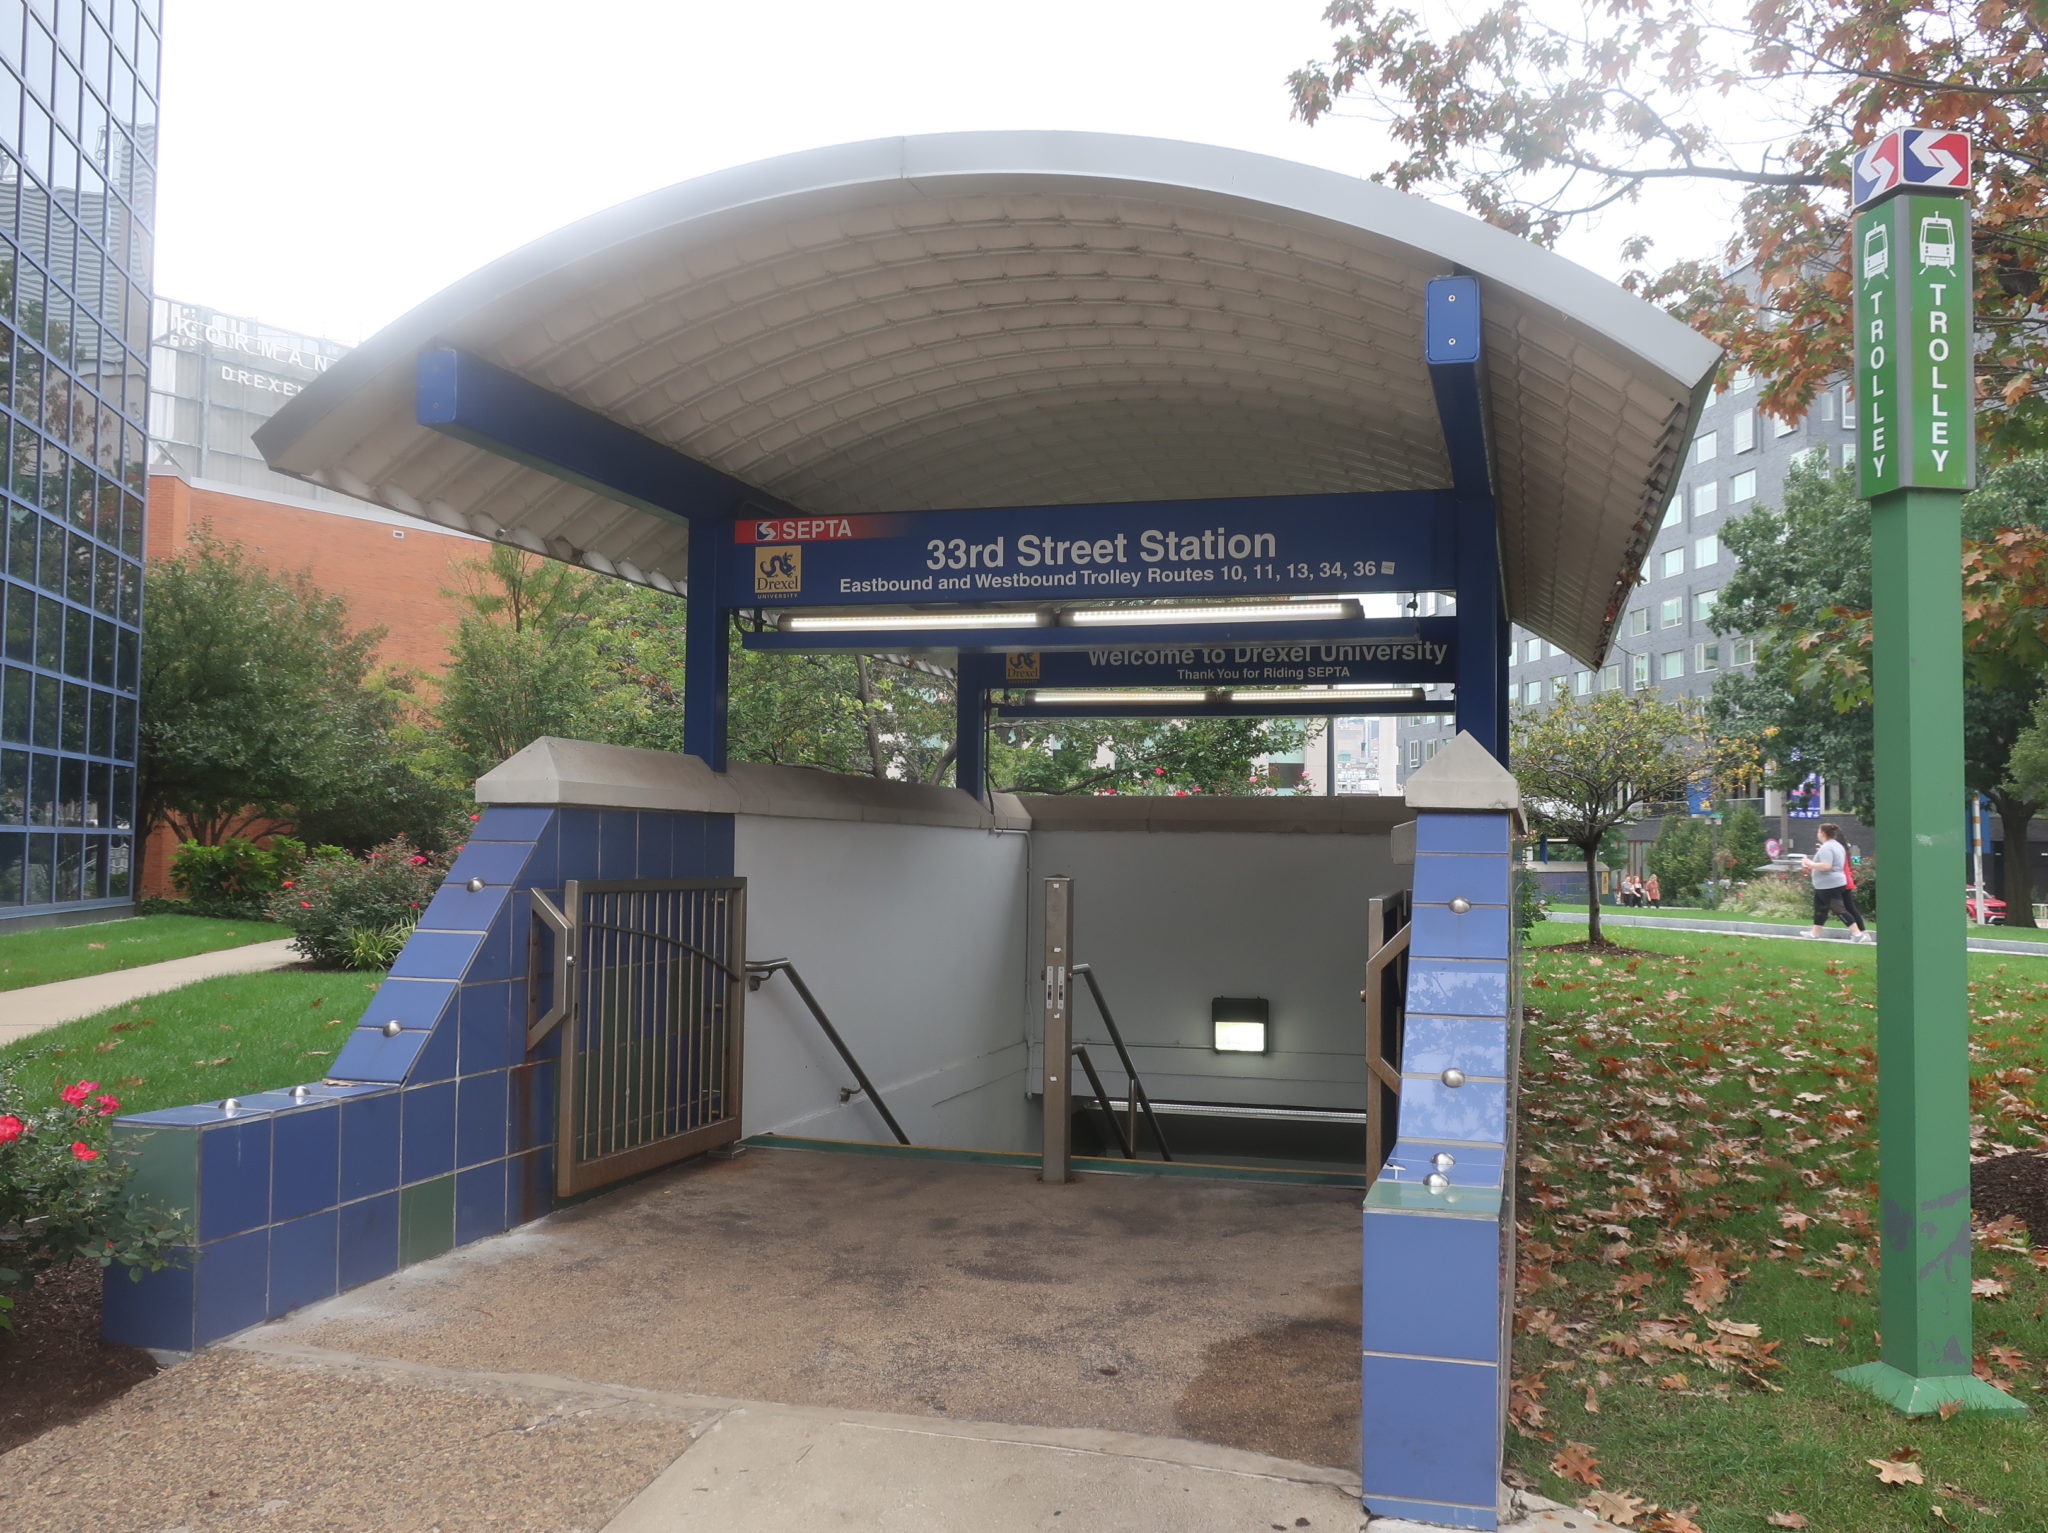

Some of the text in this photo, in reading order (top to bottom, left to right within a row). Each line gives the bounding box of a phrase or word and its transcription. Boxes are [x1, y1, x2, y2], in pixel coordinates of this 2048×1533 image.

[174, 317, 328, 372] KORMAN
[1870, 291, 1885, 478] TROLLEY
[1928, 284, 1949, 472] TROLLEY
[782, 519, 852, 539] SEPTA
[926, 527, 1276, 570] 33rd Street Station
[757, 576, 798, 591] Drexel
[840, 561, 1377, 593] Eastbound and Westbound Trolley Routes 10, 11, 13, 34, 36
[1088, 640, 1447, 666] Welcome to Drexel University
[1177, 667, 1350, 680] Thank You for Riding SEPTA
